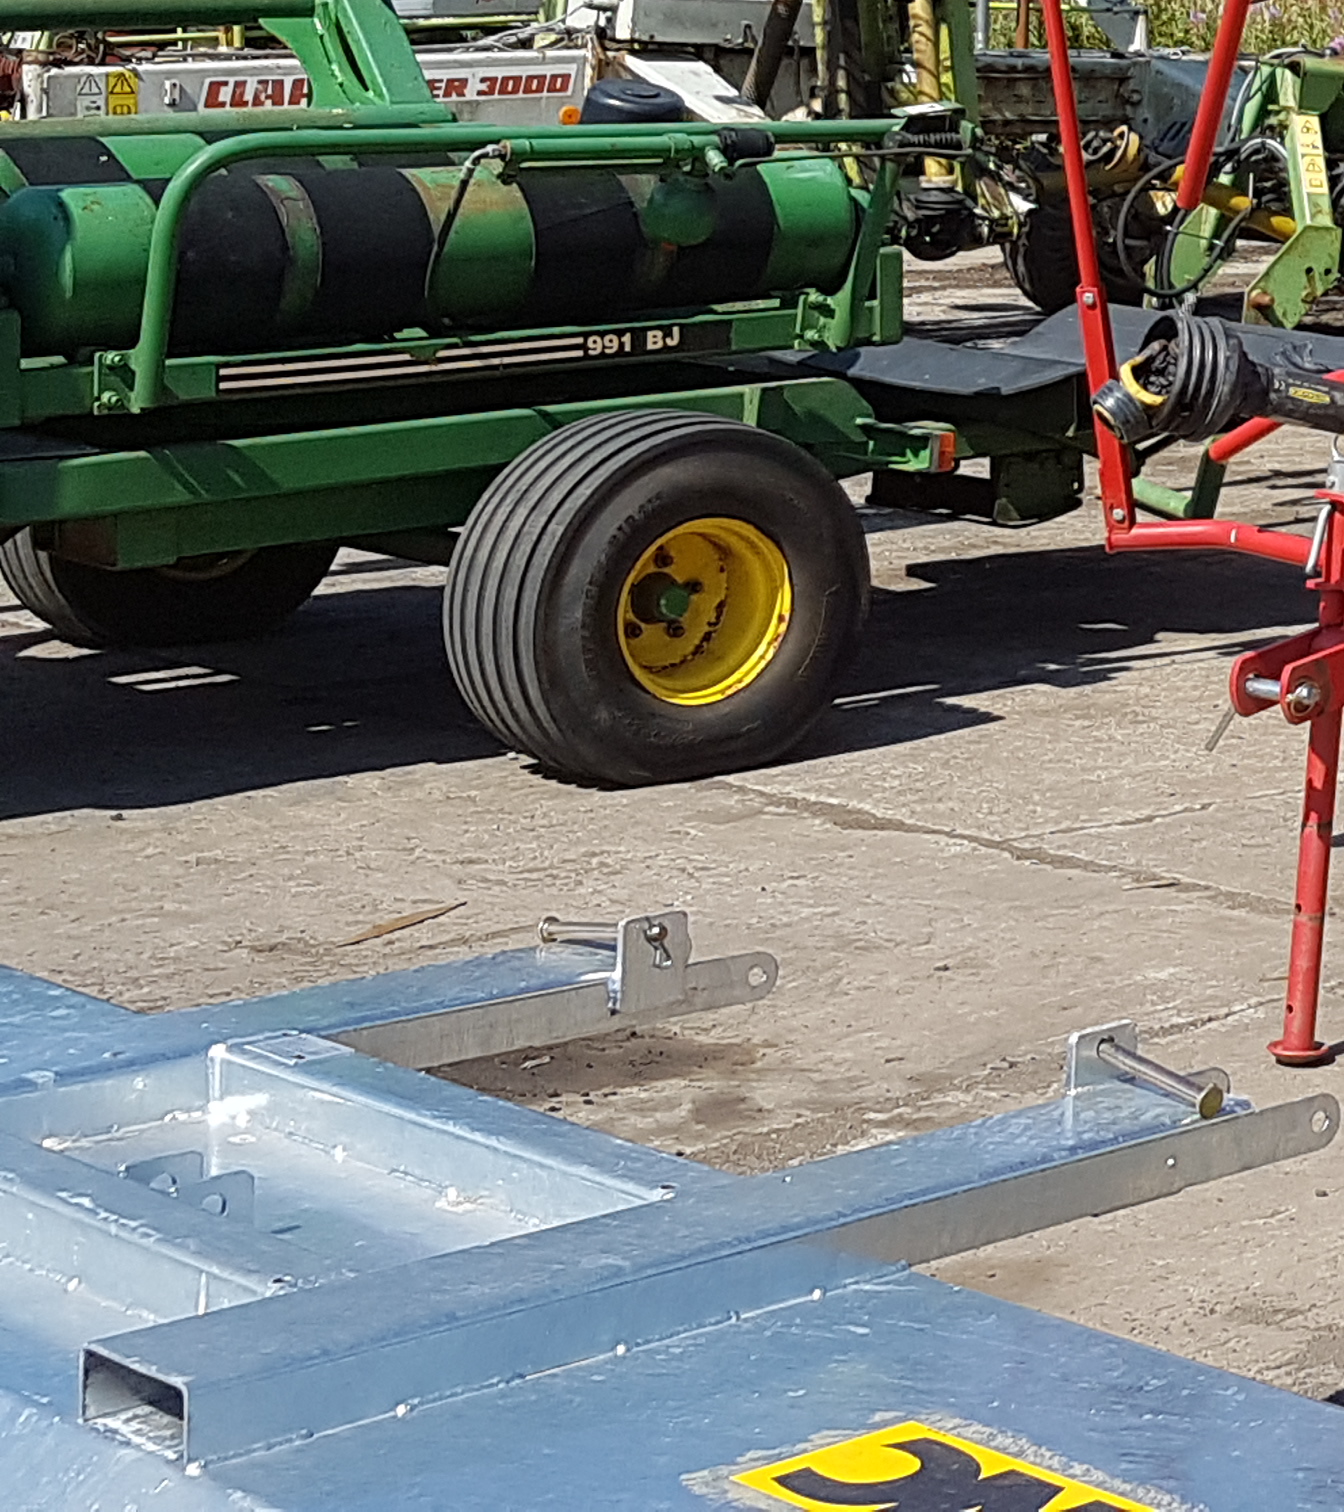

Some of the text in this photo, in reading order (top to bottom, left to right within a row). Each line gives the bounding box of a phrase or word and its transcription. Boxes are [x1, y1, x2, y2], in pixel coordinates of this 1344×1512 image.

[204, 77, 309, 108] CLAA
[476, 73, 572, 97] 3000
[587, 326, 680, 356] 991 BJ
